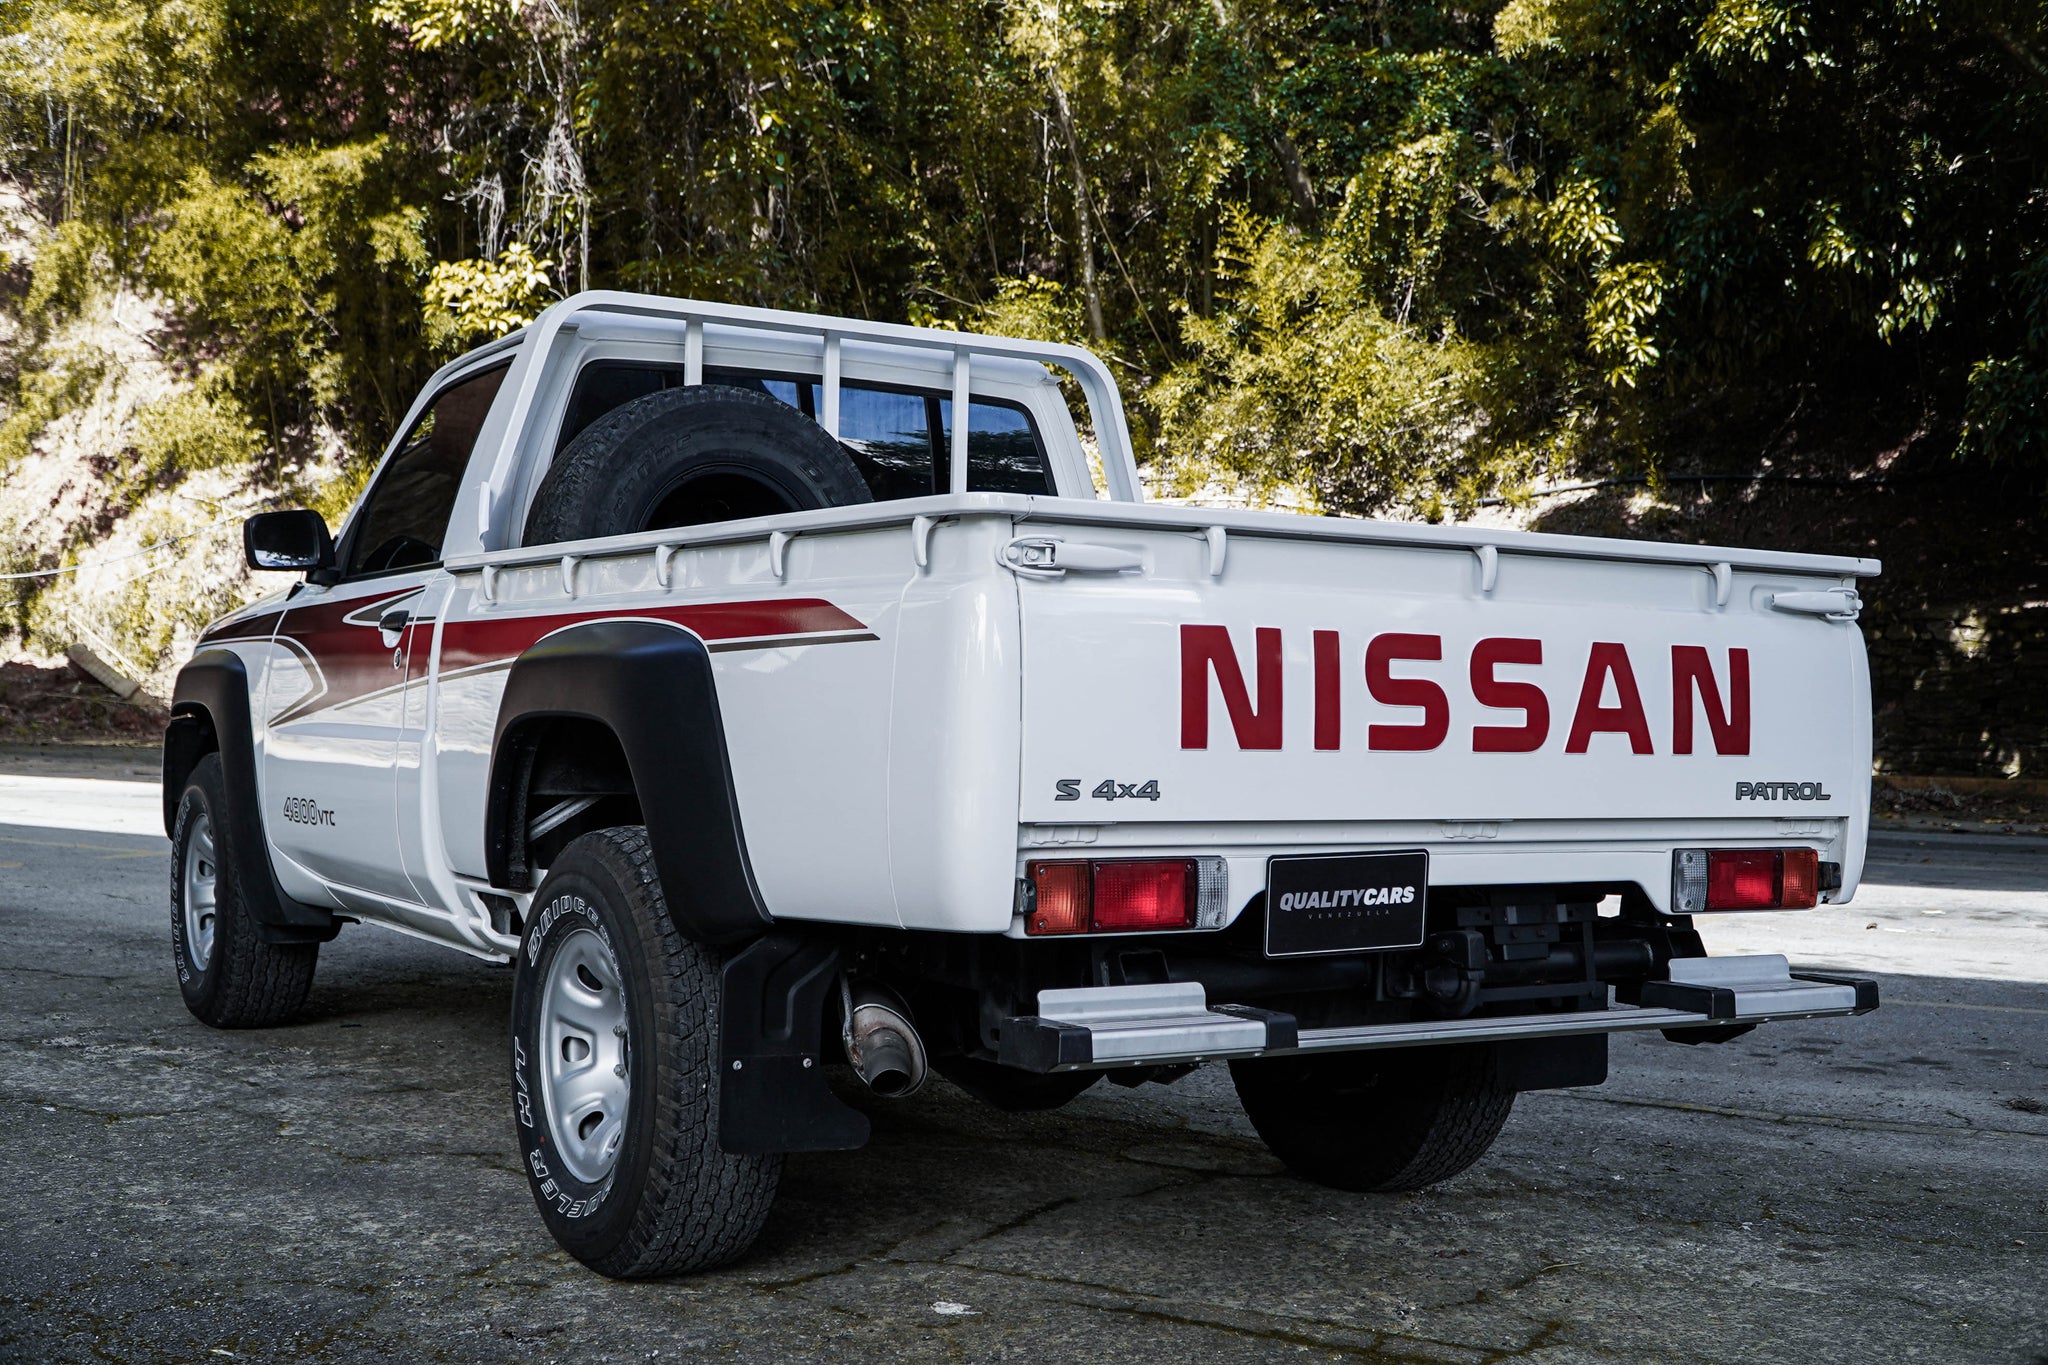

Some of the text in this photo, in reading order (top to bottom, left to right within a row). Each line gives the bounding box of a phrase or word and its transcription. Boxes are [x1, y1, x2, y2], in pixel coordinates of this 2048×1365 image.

[1179, 623, 1752, 756] NISSAN
[1054, 778, 1161, 801] S 4x4
[1735, 781, 1831, 801] PATROL
[1279, 885, 1416, 912] QUALITYCARS
[1307, 909, 1390, 920] VENEZUELA
[514, 1036, 533, 1128] H/T
